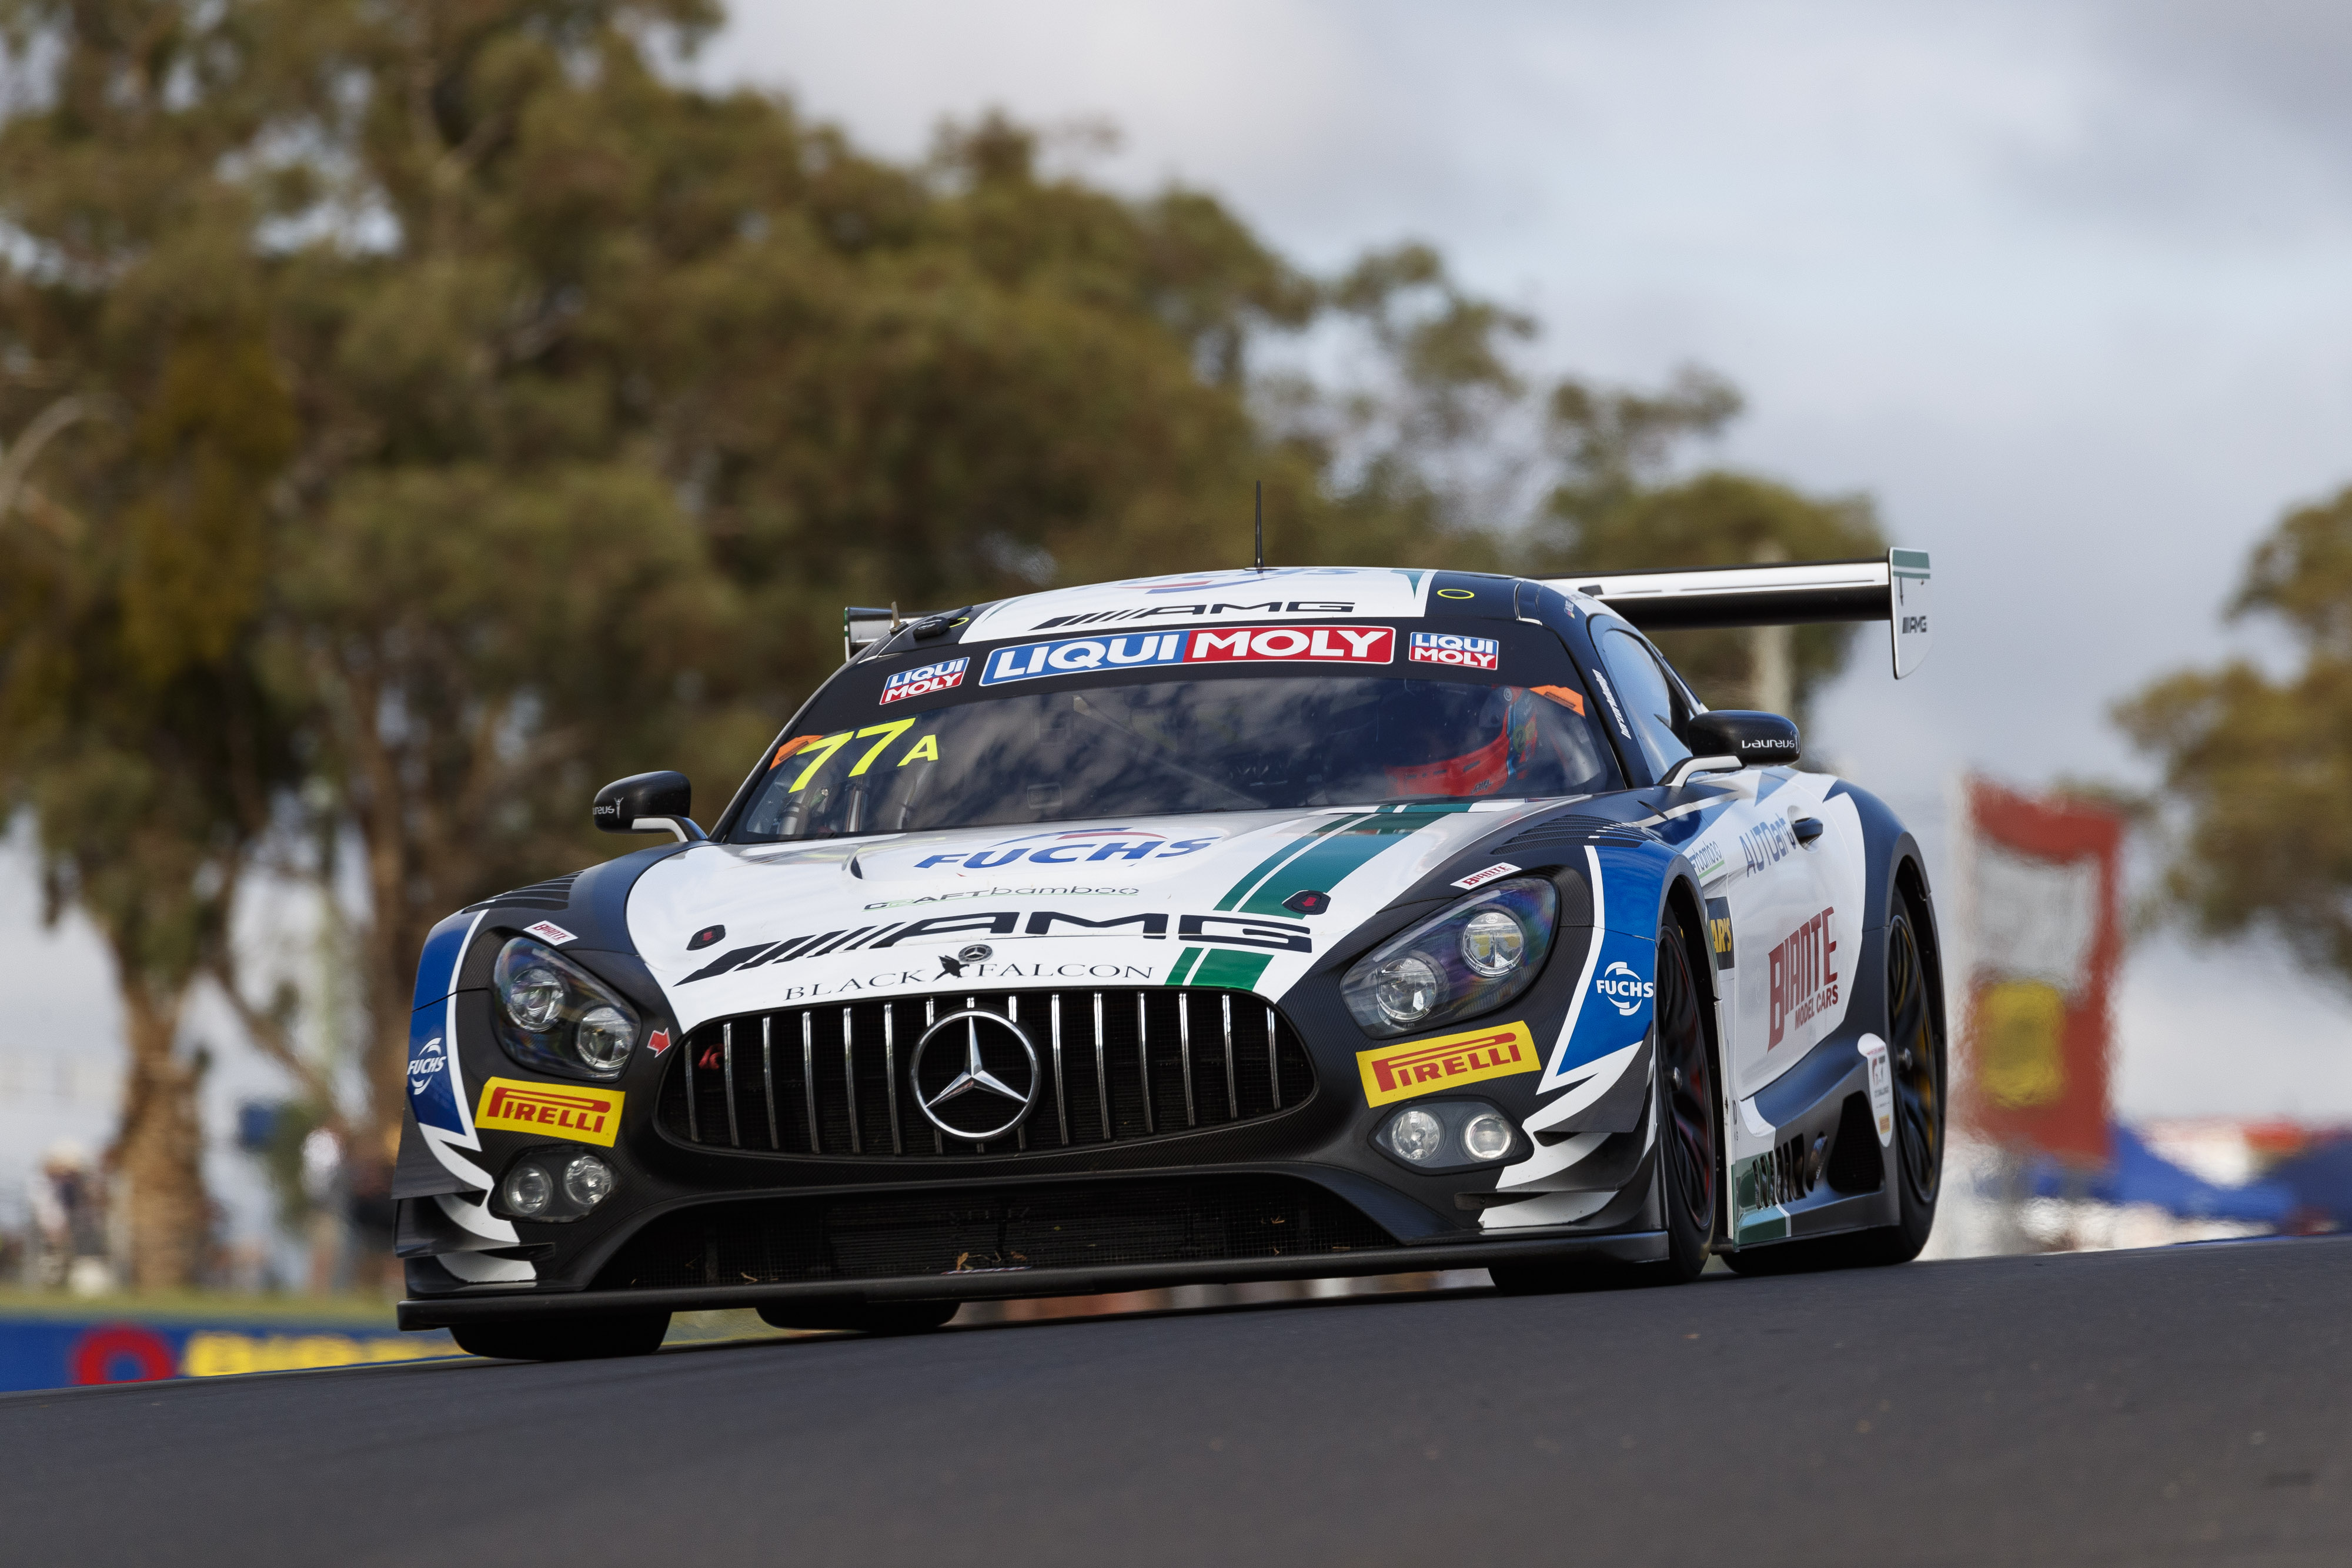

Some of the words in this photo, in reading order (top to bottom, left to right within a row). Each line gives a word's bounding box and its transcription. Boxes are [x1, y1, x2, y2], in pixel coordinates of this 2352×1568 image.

[1130, 602, 1355, 618] AMG
[994, 634, 1180, 678] LIQUI
[1192, 630, 1388, 658] MOLY
[1414, 647, 1496, 667] MOLY
[1415, 634, 1494, 654] LIQUI
[884, 673, 963, 702] MOLY
[890, 660, 965, 688] LIQUI
[788, 717, 916, 793] 77
[897, 734, 938, 767] A
[913, 836, 1224, 869] FUCHS
[868, 912, 1312, 954] AMG
[784, 969, 926, 1001] BLACK
[974, 964, 1154, 978] FALCON
[1596, 979, 1653, 998] FUCHS
[1768, 906, 1838, 1054] BIANTE
[1795, 997, 1815, 1031] MODEL
[1816, 984, 1839, 1014] CARS
[407, 1056, 447, 1076] FUCHS
[1371, 1032, 1522, 1092] PIRELLI
[487, 1086, 611, 1132] PIRELLI
